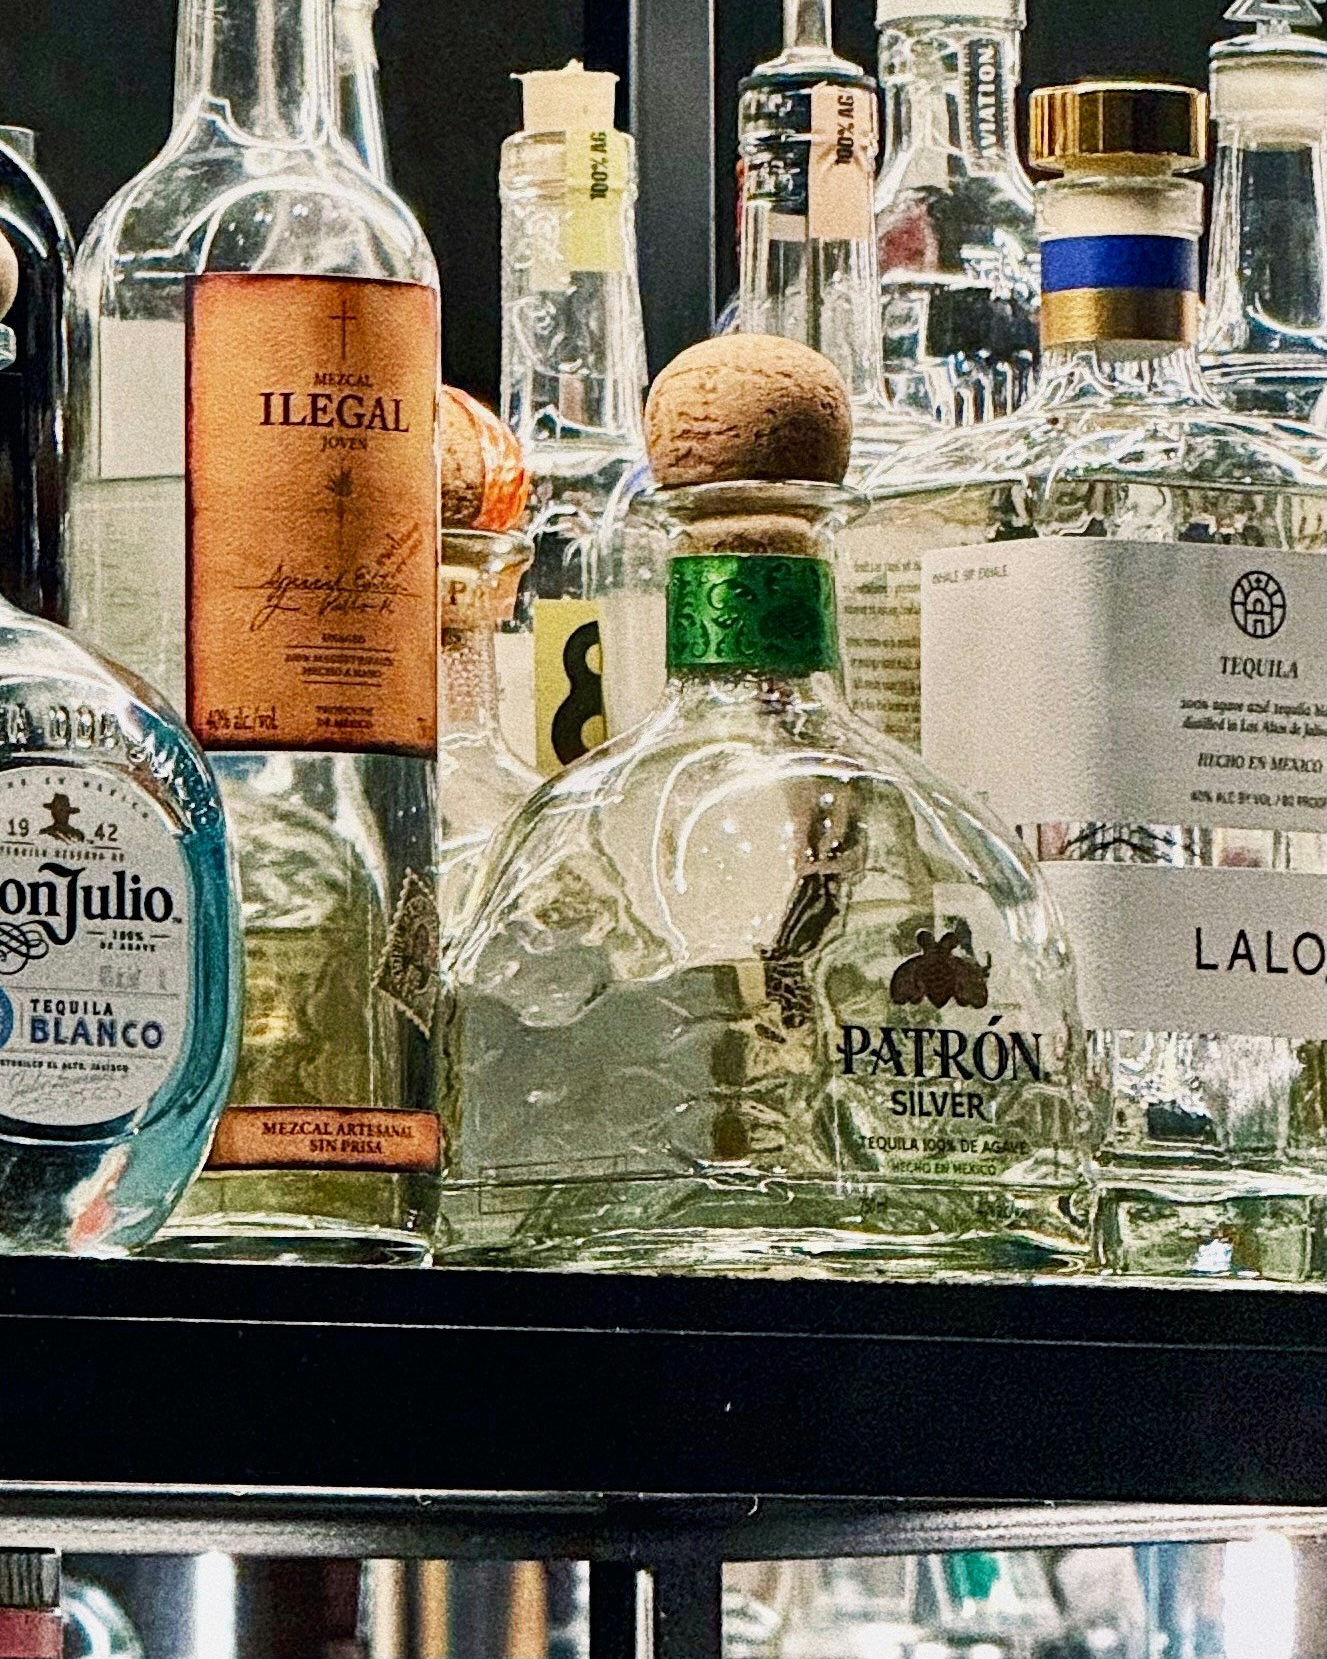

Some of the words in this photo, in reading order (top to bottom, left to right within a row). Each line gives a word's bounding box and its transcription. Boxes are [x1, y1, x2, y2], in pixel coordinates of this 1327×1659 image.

[834, 121, 855, 166] 100%
[589, 157, 609, 200] 100%
[314, 372, 374, 388] MEZCAL
[258, 391, 411, 433] ILEGAL
[321, 436, 368, 452] JOVEN
[1219, 655, 1299, 680] TEQUILA
[1198, 751, 1245, 769] HECHO
[1248, 755, 1267, 770] EN
[1270, 756, 1324, 774] MEXICO
[7, 816, 31, 838] 19
[93, 822, 119, 842] 42
[1195, 926, 1326, 976] LALO
[29, 998, 115, 1017] TEQUILA
[29, 1015, 165, 1050] BLANCO
[836, 1014, 1043, 1082] PATRÓN
[890, 1089, 989, 1121] SILVER
[261, 1121, 333, 1137] MEZCAL
[336, 1122, 415, 1139] ARTESANAL
[309, 1139, 337, 1153] SIN
[340, 1140, 383, 1155] PRISA
[860, 1134, 920, 1153] TEQUILA
[960, 1138, 979, 1154] DE
[982, 1139, 1032, 1156] AGAVE
[891, 1161, 932, 1175] HECHO
[934, 1162, 950, 1175] EN
